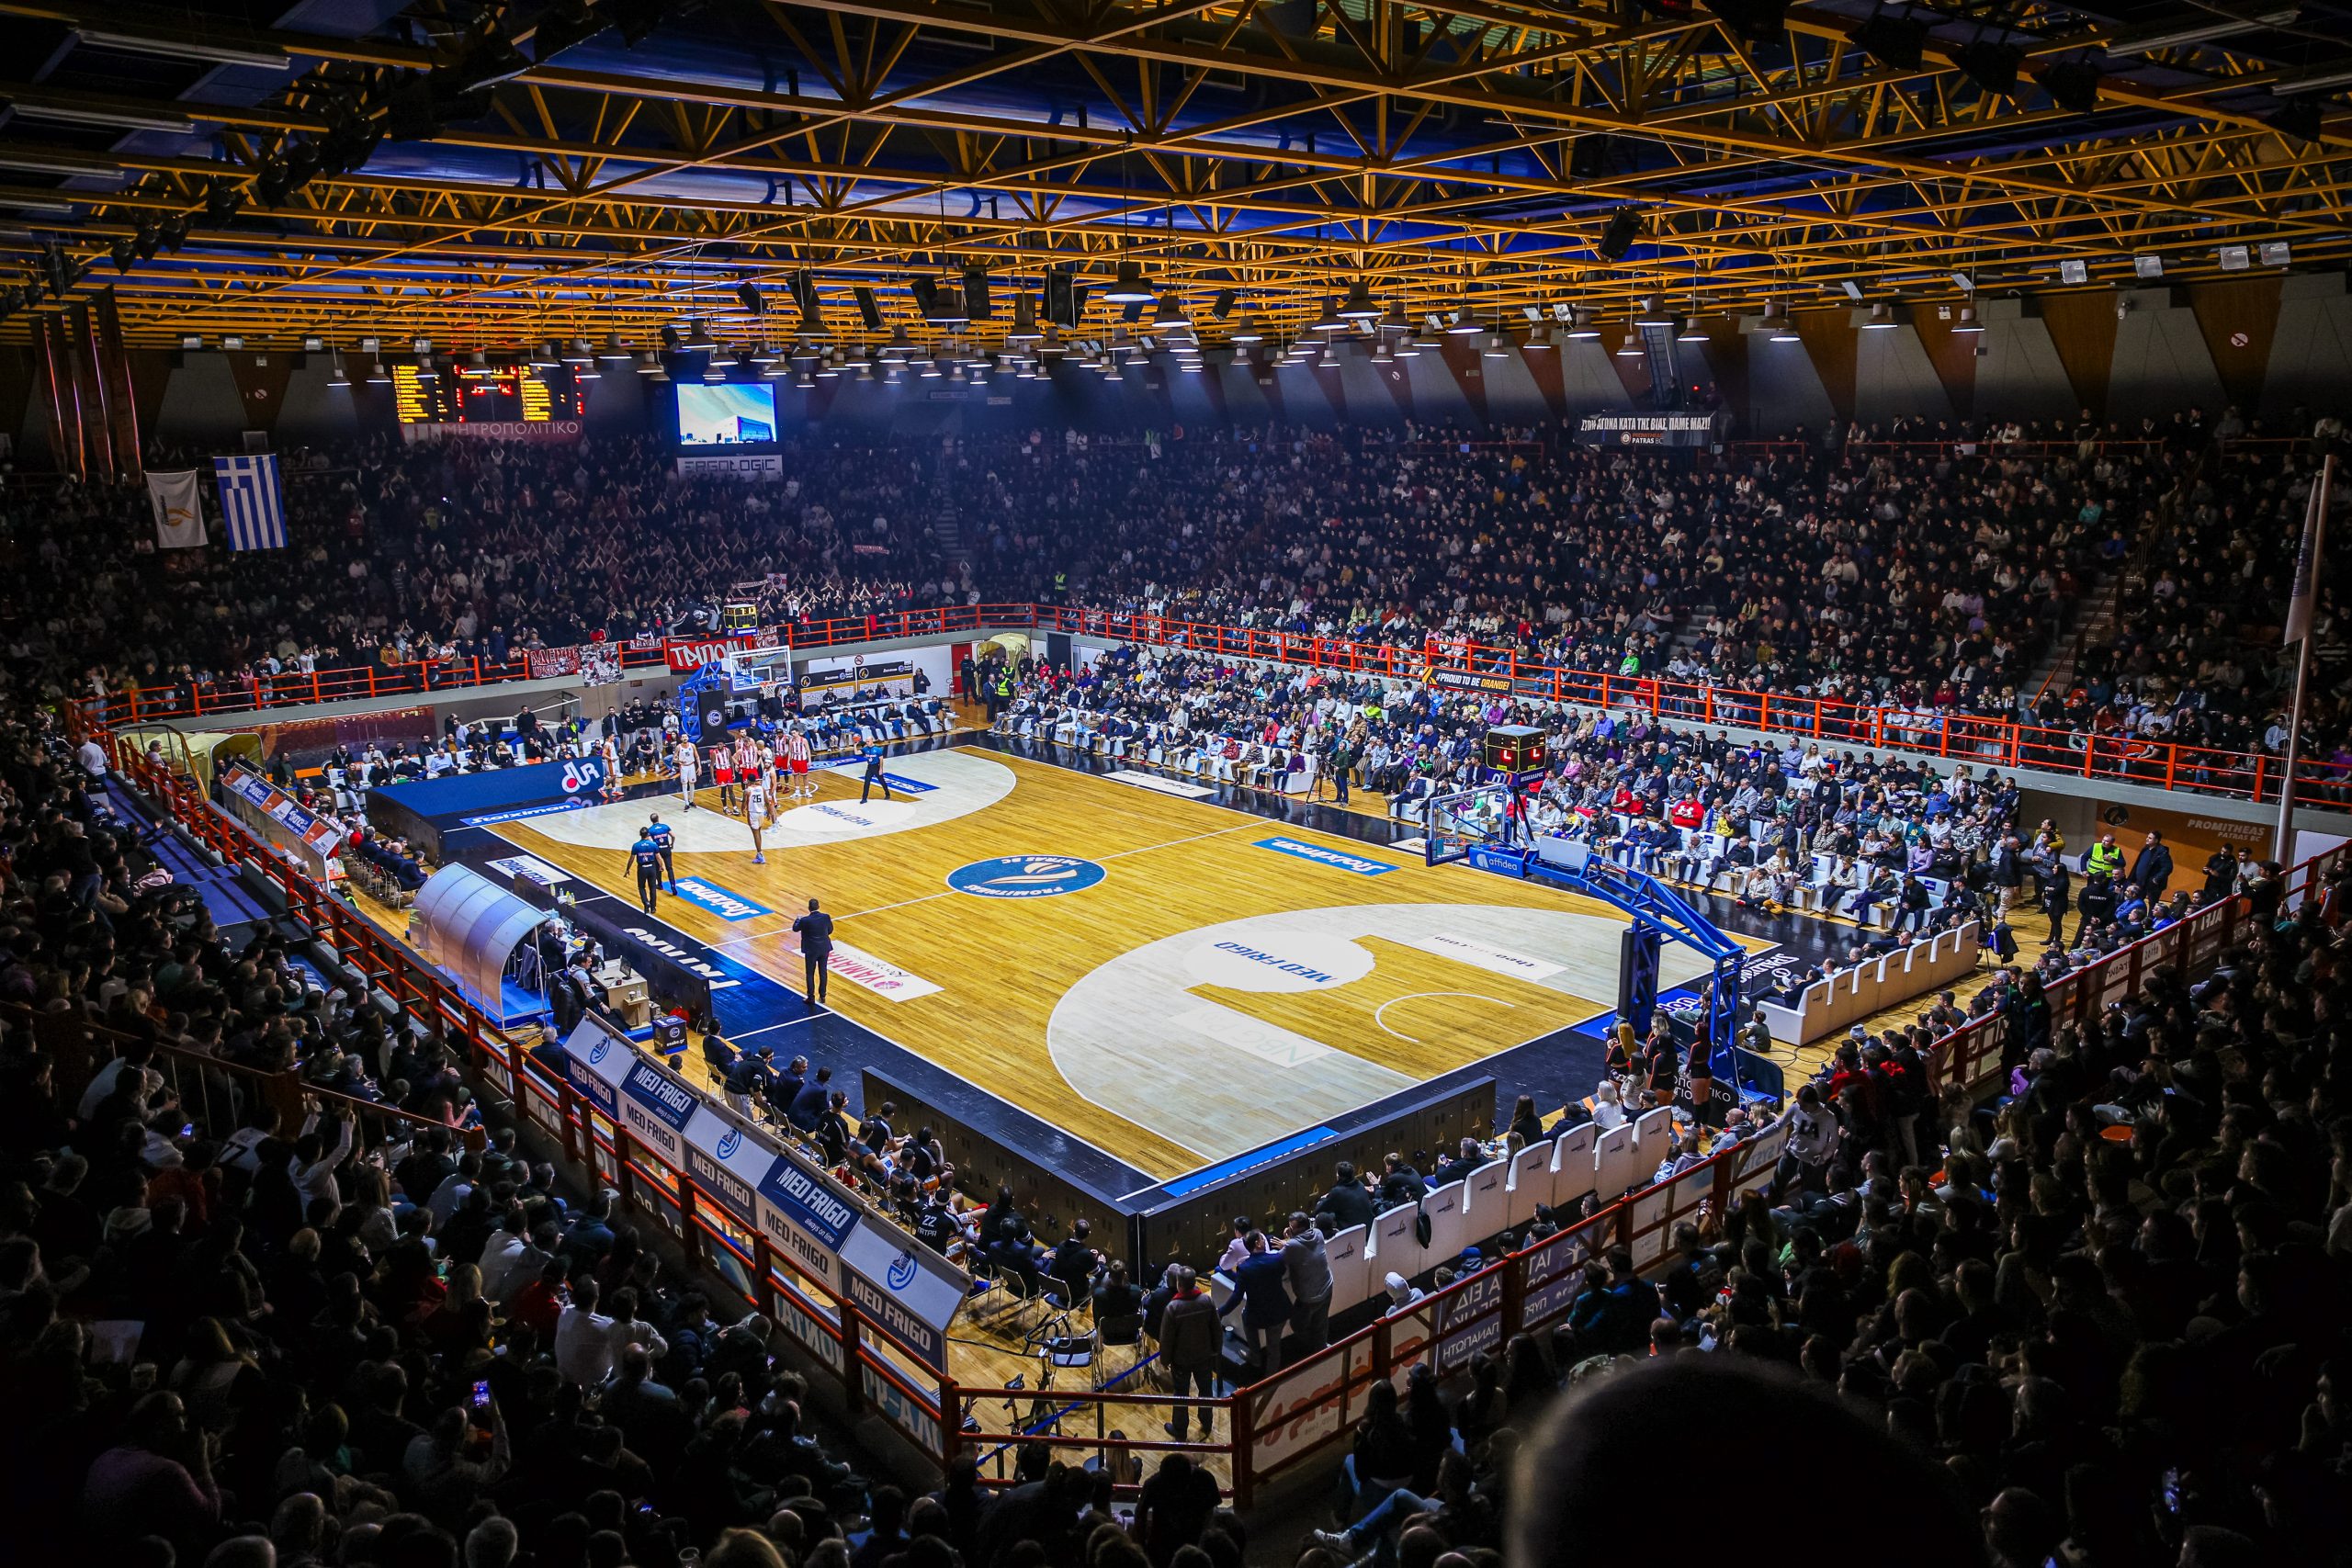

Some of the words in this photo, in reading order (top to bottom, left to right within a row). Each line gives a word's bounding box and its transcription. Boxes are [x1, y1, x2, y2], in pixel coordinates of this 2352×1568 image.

[1619, 418, 1635, 430] ΚΑΤΑ
[1637, 418, 1649, 430] ΤΗΣ
[1668, 417, 1689, 430] ΠΑΜΕ
[1436, 672, 1462, 683] #PROUD
[1463, 676, 1470, 685] TO
[1471, 678, 1480, 686] BE
[1481, 678, 1510, 690] ORANGE!
[2188, 818, 2266, 836] PROMITHEAS
[2218, 831, 2248, 841] PATRAS
[1488, 856, 1518, 871] affidea
[1213, 942, 1286, 965] FRIGO
[1278, 964, 1339, 983] MED
[570, 1060, 587, 1084] MED
[588, 1077, 612, 1105] FRIGO
[633, 1066, 660, 1089] MED
[655, 1080, 692, 1113] FRIGO
[626, 1103, 646, 1130] MED
[647, 1119, 675, 1153] FRIGO
[692, 1152, 715, 1182] MED
[717, 1169, 750, 1208] FRIGO
[775, 1167, 812, 1198] MED
[804, 1187, 851, 1229] FRIGO
[804, 1218, 820, 1232] always
[825, 1232, 835, 1244] time
[922, 1214, 937, 1228] 22
[764, 1209, 790, 1242] MED
[791, 1229, 829, 1274] FRIGO
[851, 1276, 883, 1315] MED
[884, 1300, 932, 1352] FRIGO
